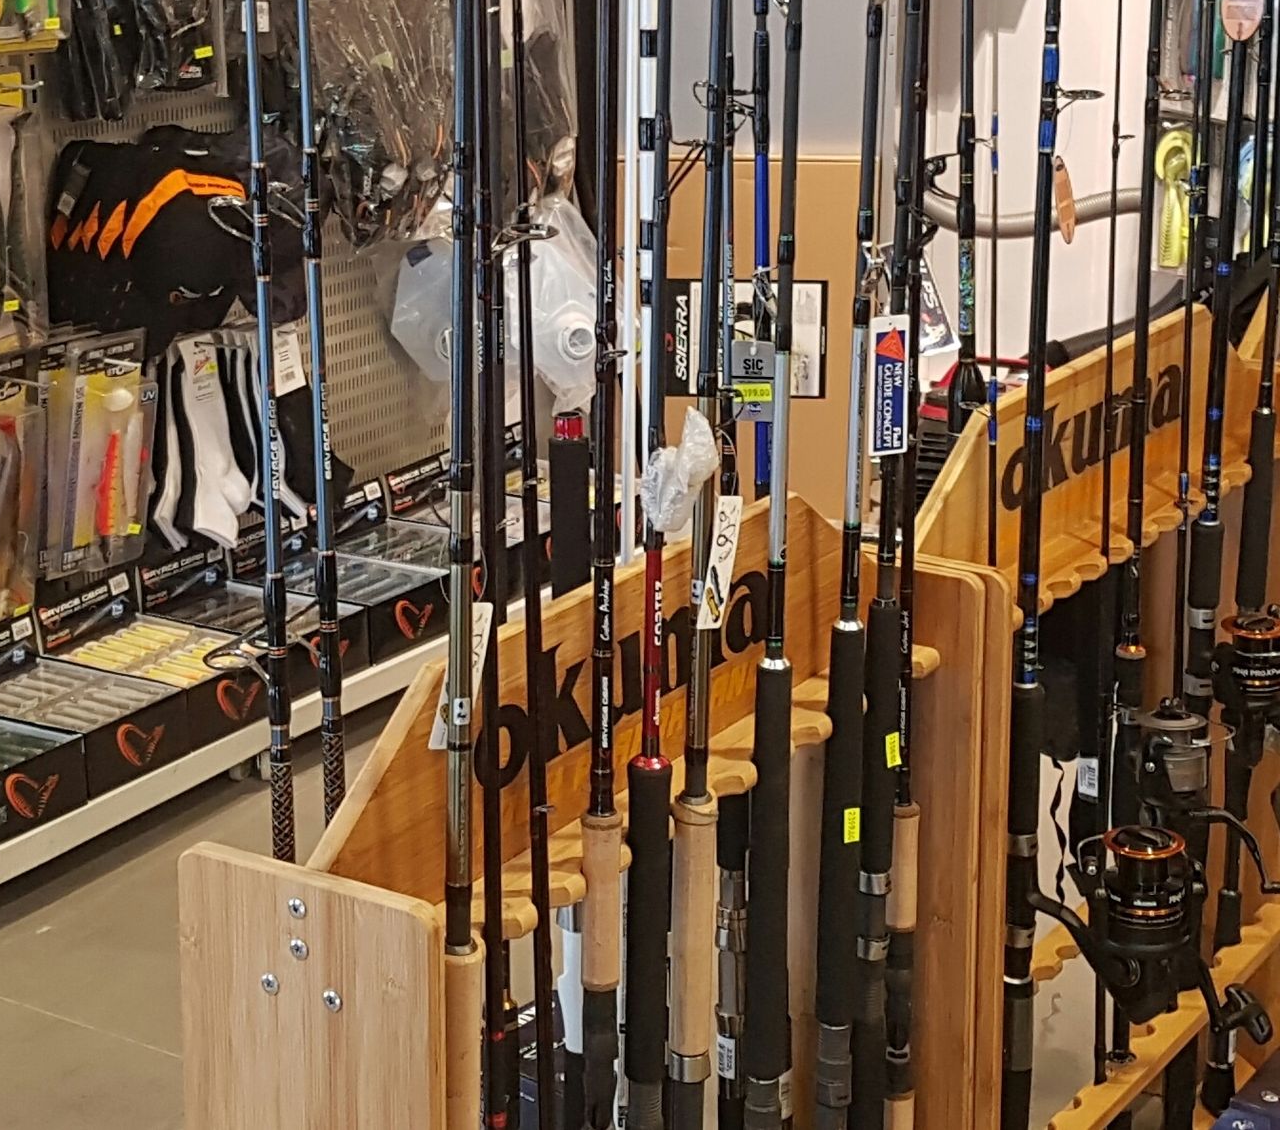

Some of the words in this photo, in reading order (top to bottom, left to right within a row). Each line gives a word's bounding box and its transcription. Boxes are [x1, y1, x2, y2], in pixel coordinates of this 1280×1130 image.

[676, 294, 689, 382] SCIERRA
[141, 390, 156, 403] UV
[883, 364, 893, 399] GUIDE
[893, 362, 903, 388] NEW
[883, 399, 893, 449] CONCEPT
[1001, 365, 1183, 511] okuma
[40, 596, 81, 621] SAVAGE
[82, 584, 108, 604] GEAR
[474, 572, 767, 790] okuma
